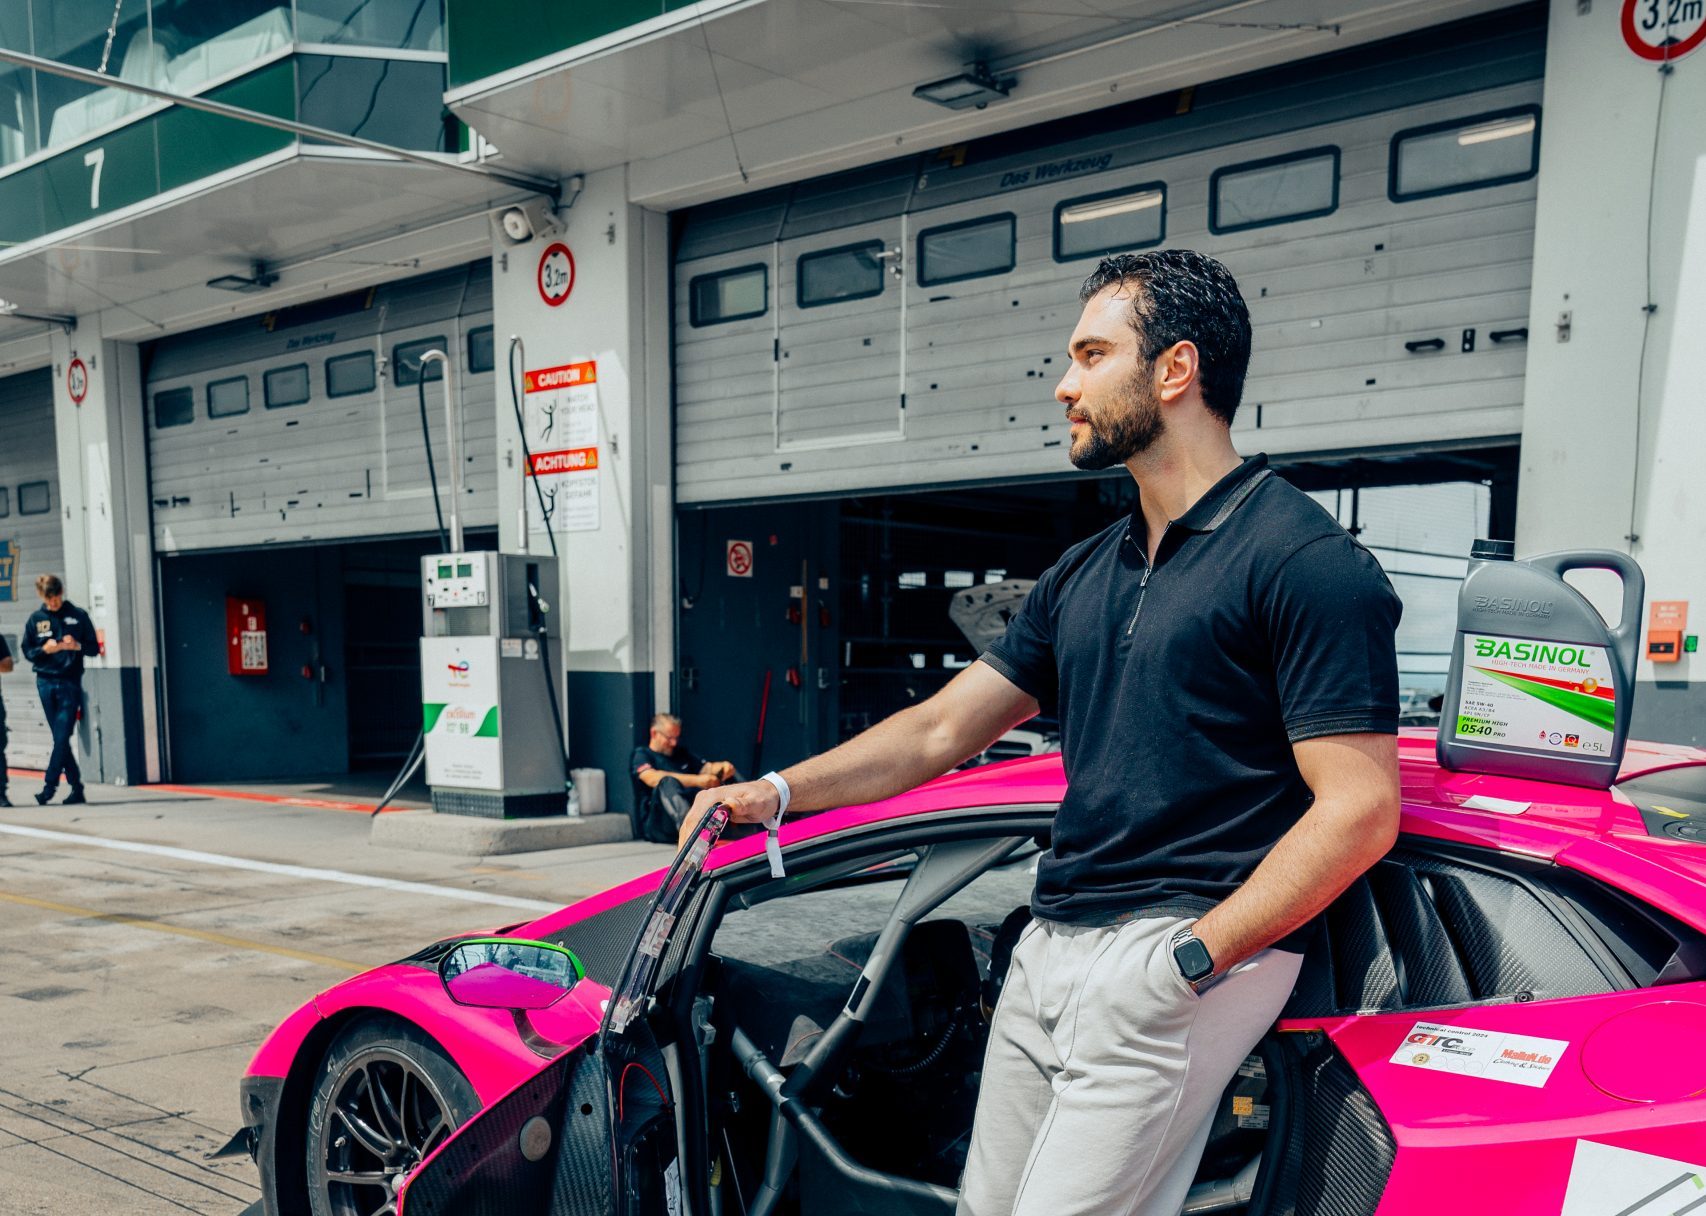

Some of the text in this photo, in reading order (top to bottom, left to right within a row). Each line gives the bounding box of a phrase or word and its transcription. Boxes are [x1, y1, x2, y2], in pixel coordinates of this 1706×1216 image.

[84, 147, 104, 209] 7
[1000, 154, 1112, 187] Das Werkzeug
[918, 175, 928, 190] 6
[538, 369, 580, 387] CAUTION
[535, 452, 586, 471] ACHTUNG
[1474, 594, 1550, 614] BASINOL
[1474, 639, 1591, 667] BASINOL
[1491, 660, 1527, 668] HIGH-TECH
[1529, 663, 1547, 671] MADE
[1558, 666, 1590, 675] GERMANY
[1461, 724, 1492, 735] 0540
[1592, 742, 1605, 752] 5L
